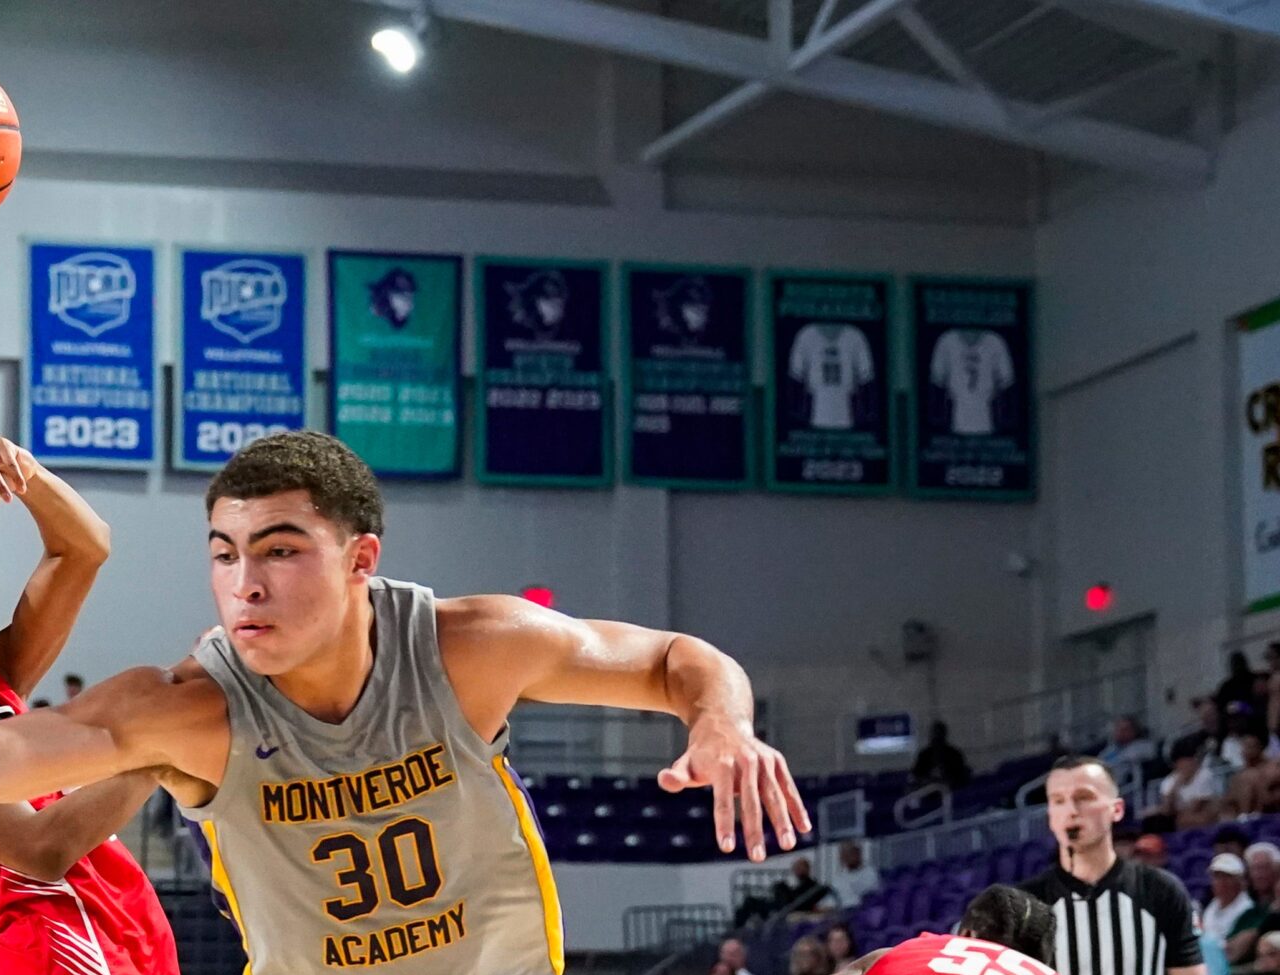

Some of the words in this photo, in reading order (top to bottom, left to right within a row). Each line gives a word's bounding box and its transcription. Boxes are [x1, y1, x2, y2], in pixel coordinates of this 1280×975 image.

[44, 416, 140, 449] 2023
[259, 744, 456, 823] MONTVERDE
[311, 816, 445, 922] 30
[323, 900, 466, 967] ACADEMY
